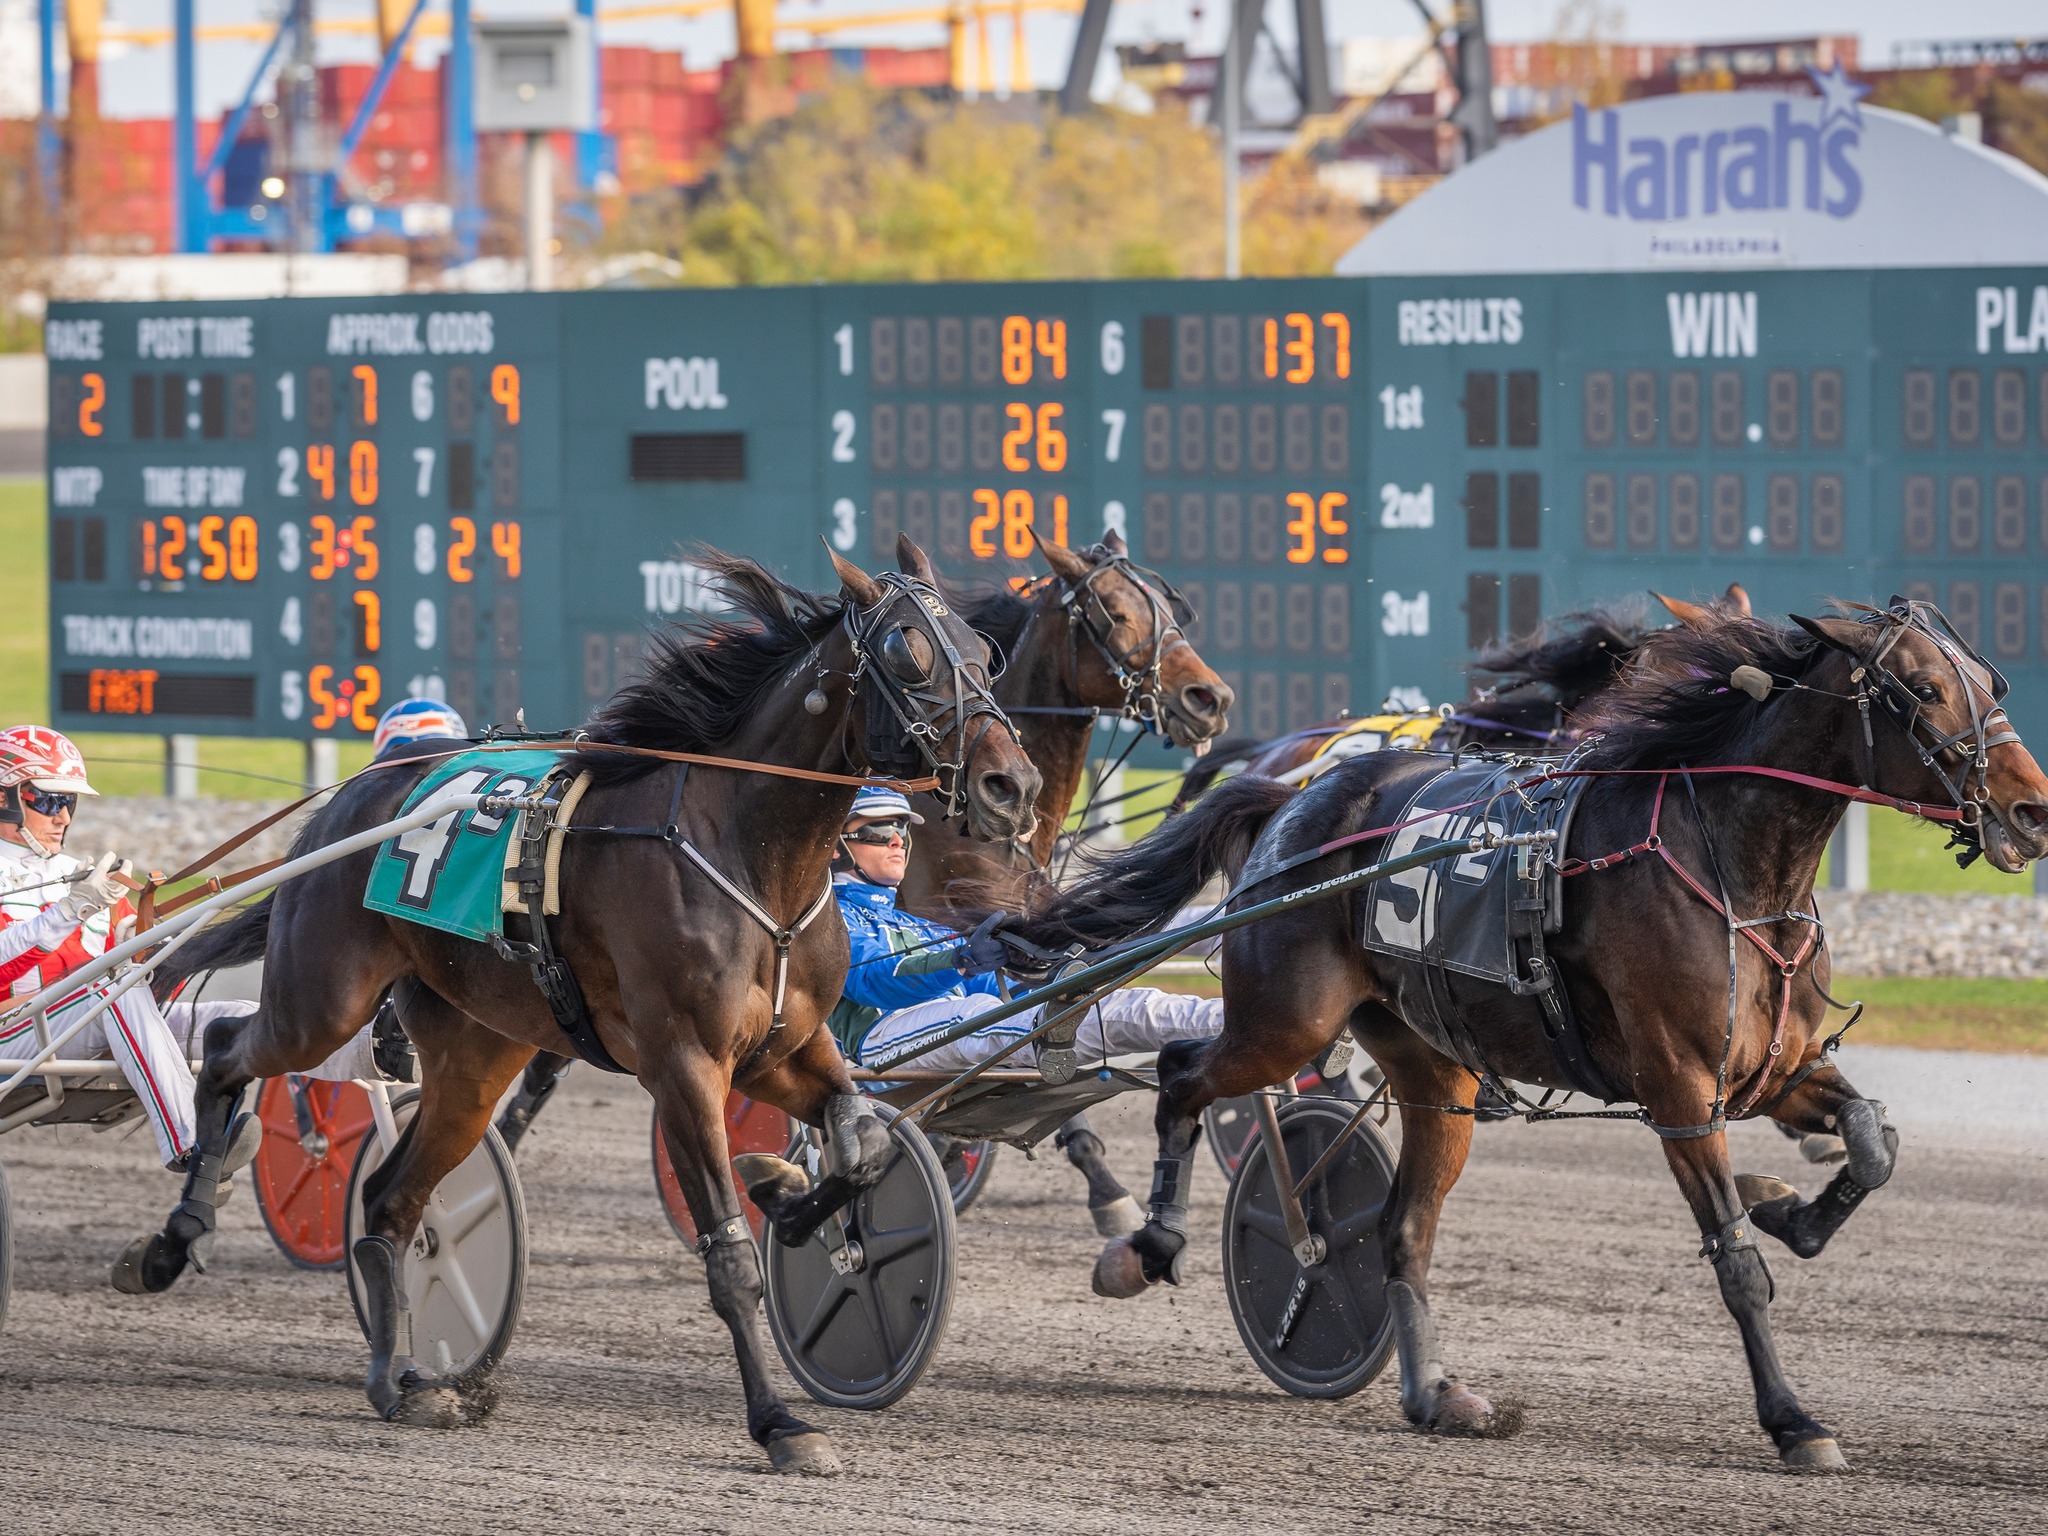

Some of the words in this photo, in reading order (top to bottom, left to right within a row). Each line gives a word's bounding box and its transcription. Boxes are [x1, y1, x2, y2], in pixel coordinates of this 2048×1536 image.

[137, 316, 195, 359] POST
[198, 316, 254, 358] TIME
[427, 311, 494, 354] ODDS
[1101, 320, 1125, 375] 6
[1264, 312, 1350, 384] 137
[1398, 298, 1523, 345] RESULTS
[1666, 291, 1758, 358] WIN
[833, 323, 854, 376] 1
[1002, 315, 1068, 385] 84
[79, 373, 105, 437] 2
[276, 371, 295, 421] 1
[352, 364, 378, 426] 7
[411, 369, 434, 421] 6
[491, 364, 521, 426] 9
[645, 357, 728, 410] POOL
[1379, 384, 1424, 430] 1st
[832, 409, 856, 463] 2
[1002, 402, 1068, 472] 26
[1102, 408, 1127, 463] 7
[277, 446, 299, 497] 2
[307, 440, 379, 505] 40
[413, 447, 436, 498] 7
[832, 497, 857, 551] 3
[969, 488, 1069, 558] 281
[1380, 482, 1435, 529] 2nd
[142, 515, 258, 581] 12:50
[278, 521, 301, 572] 3
[414, 523, 436, 575] 8
[447, 516, 521, 583] 24
[62, 614, 134, 657] TRACK
[135, 616, 252, 660] CONDITION
[279, 596, 303, 646] 4
[353, 590, 380, 651] 7
[414, 598, 437, 650] 9
[1381, 590, 1430, 636] 3rd
[88, 668, 159, 714] FAST
[281, 670, 304, 721] 5
